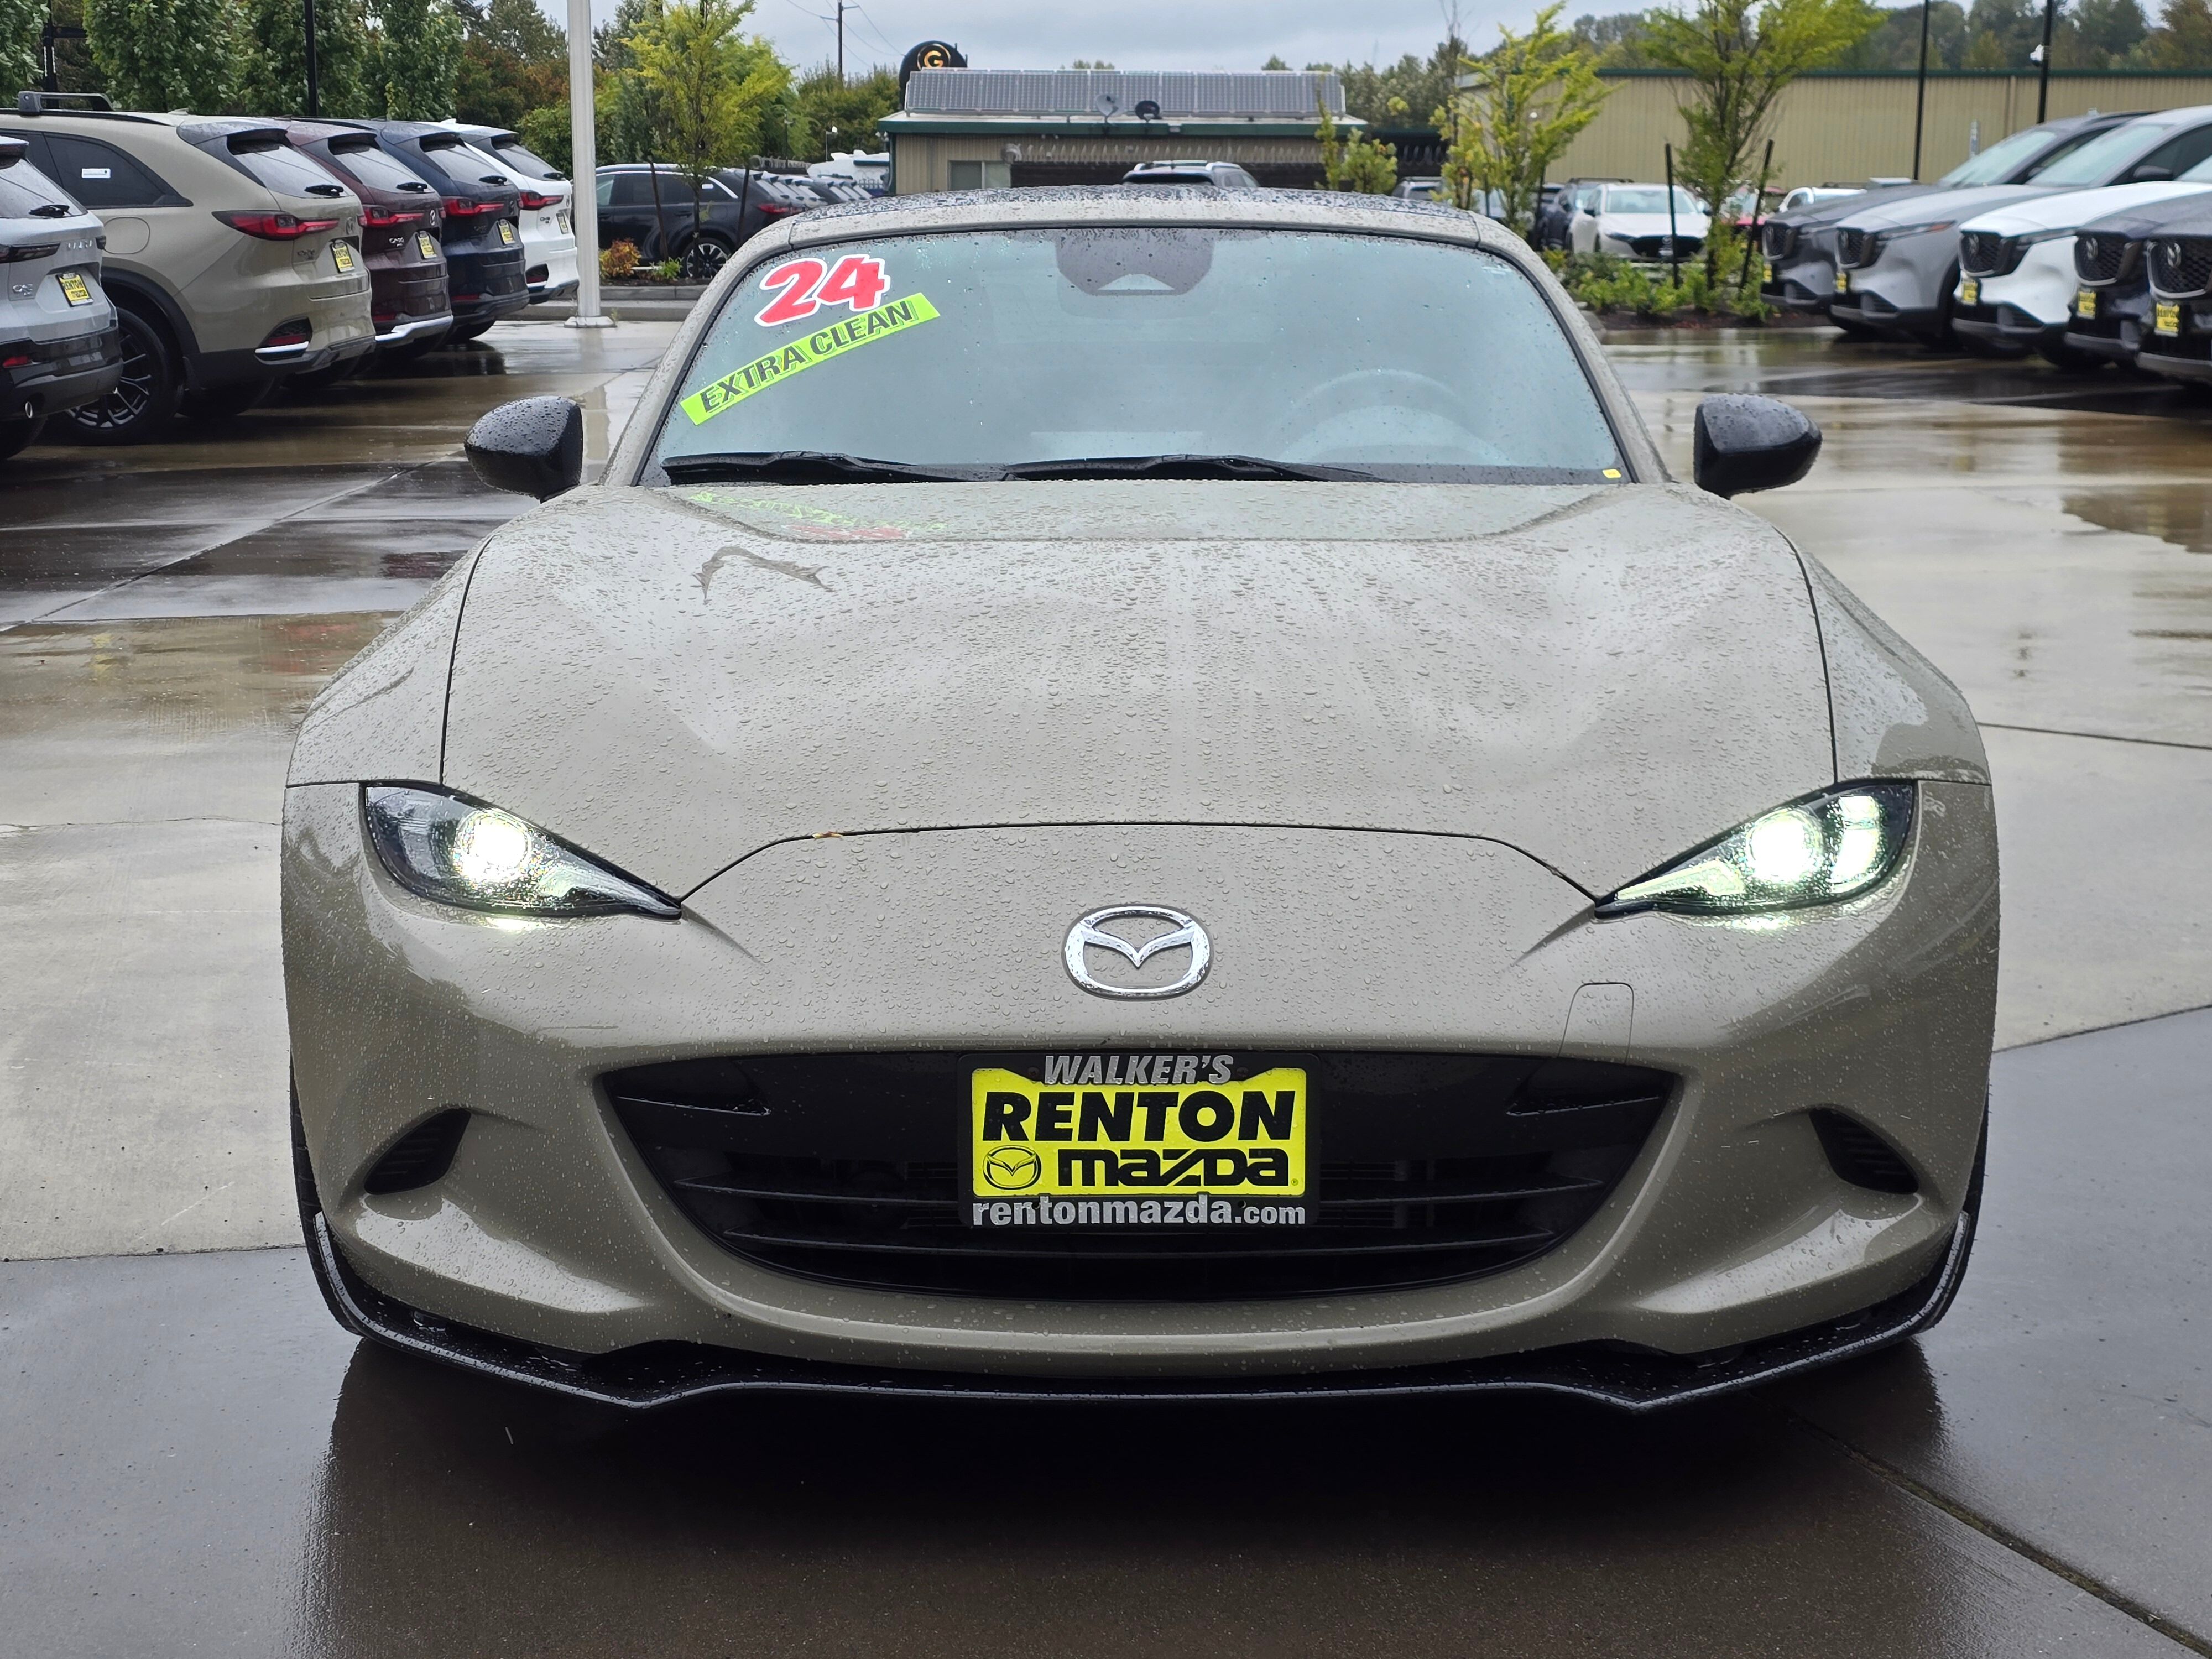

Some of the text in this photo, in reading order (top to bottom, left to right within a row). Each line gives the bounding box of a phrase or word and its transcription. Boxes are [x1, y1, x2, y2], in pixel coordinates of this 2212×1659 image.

[924, 50, 943, 67] G
[754, 254, 891, 327] 24
[700, 300, 917, 413] EXTRA CLEAN
[1044, 1054, 1234, 1085] WALKER'S
[982, 1089, 1296, 1142] RENTON
[1057, 1147, 1289, 1187] mazda
[973, 1194, 1306, 1226] rentonmazda.com
